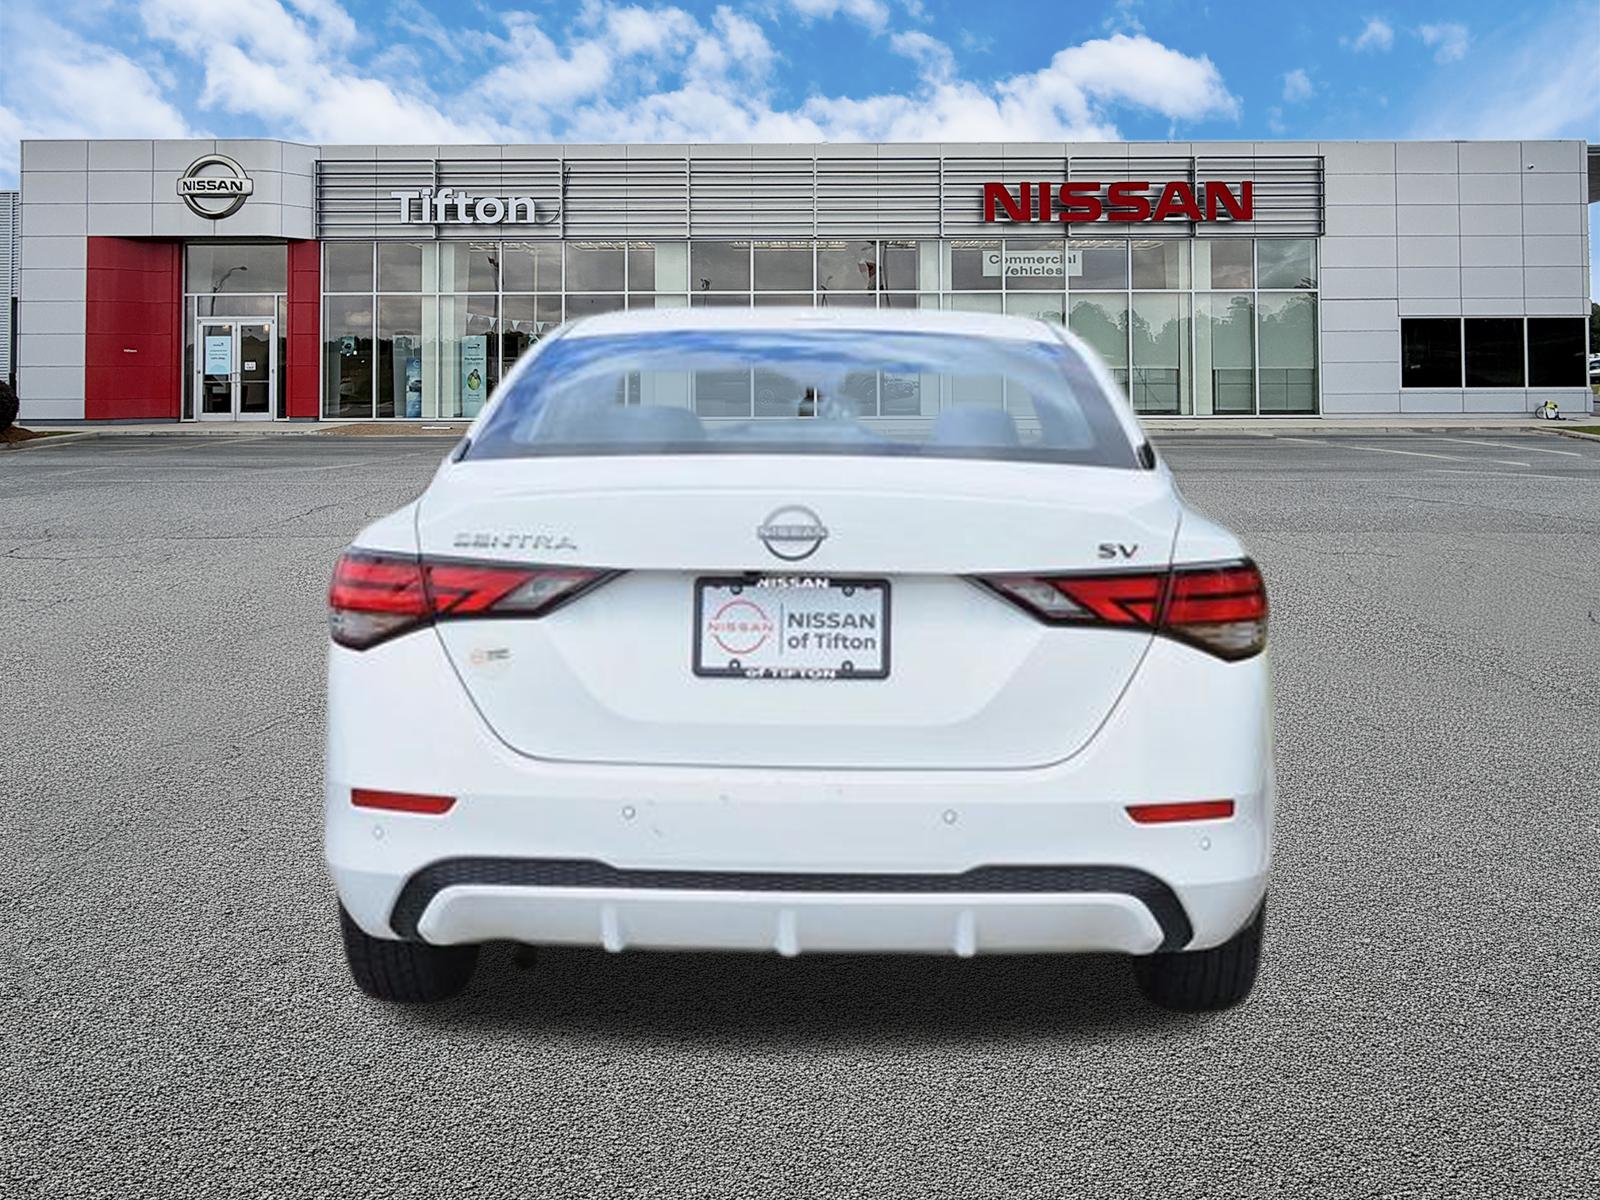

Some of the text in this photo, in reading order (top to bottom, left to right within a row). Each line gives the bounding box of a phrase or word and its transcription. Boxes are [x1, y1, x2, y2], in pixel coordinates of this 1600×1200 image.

[182, 181, 244, 192] NISSAN
[390, 187, 537, 225] Tifton
[983, 180, 1254, 222] NISSAN
[988, 254, 1076, 265] Commercial
[759, 527, 826, 538] NISSAN
[453, 532, 577, 550] SENTRA
[1097, 543, 1138, 559] SV
[756, 577, 829, 588] NISSAN
[707, 622, 773, 632] NISSAN
[788, 613, 876, 629] NISSAN
[788, 633, 877, 649] of Tifton
[771, 667, 836, 678] TIFTON
